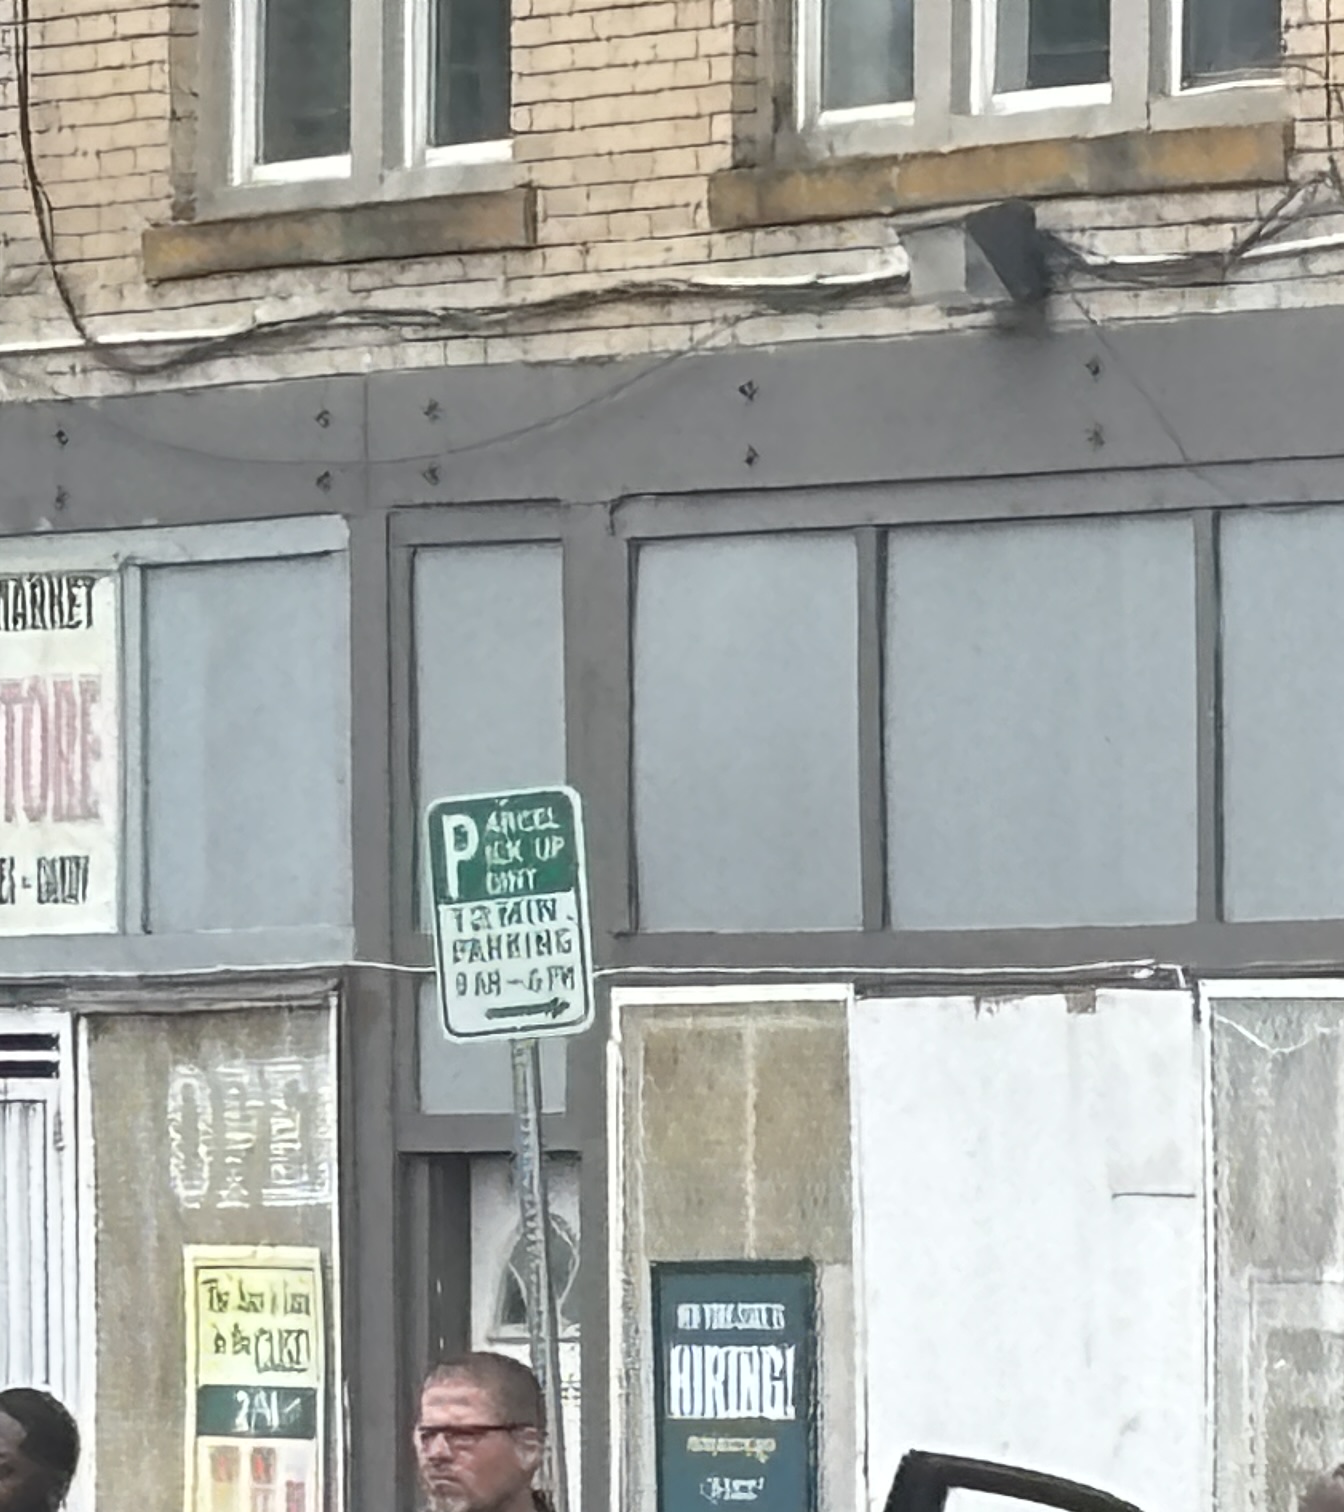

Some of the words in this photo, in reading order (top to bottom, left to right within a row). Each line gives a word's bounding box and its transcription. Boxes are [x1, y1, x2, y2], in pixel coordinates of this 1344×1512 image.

[535, 836, 566, 861] UP
[499, 898, 557, 928] MIN
[452, 927, 573, 965] PARKING
[669, 1343, 797, 1421] HIRING!
